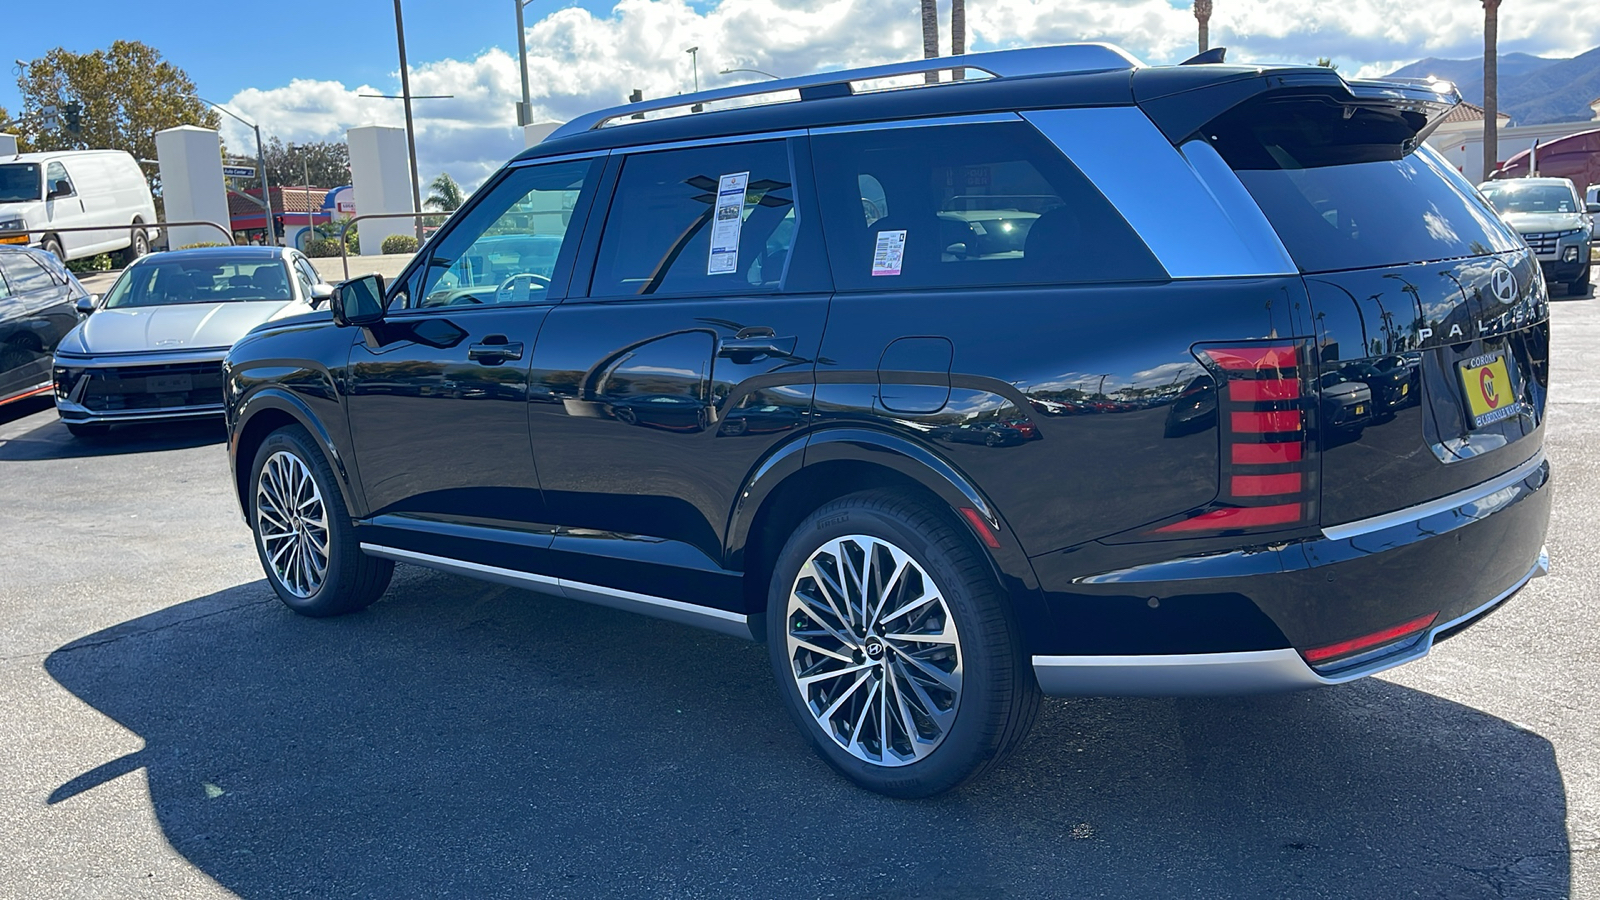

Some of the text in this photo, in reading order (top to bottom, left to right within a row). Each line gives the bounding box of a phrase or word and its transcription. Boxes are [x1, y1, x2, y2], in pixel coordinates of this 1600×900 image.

[1418, 303, 1545, 342] PALISAD
[1470, 354, 1496, 368] CORONA
[817, 511, 849, 530] PIRELLI
